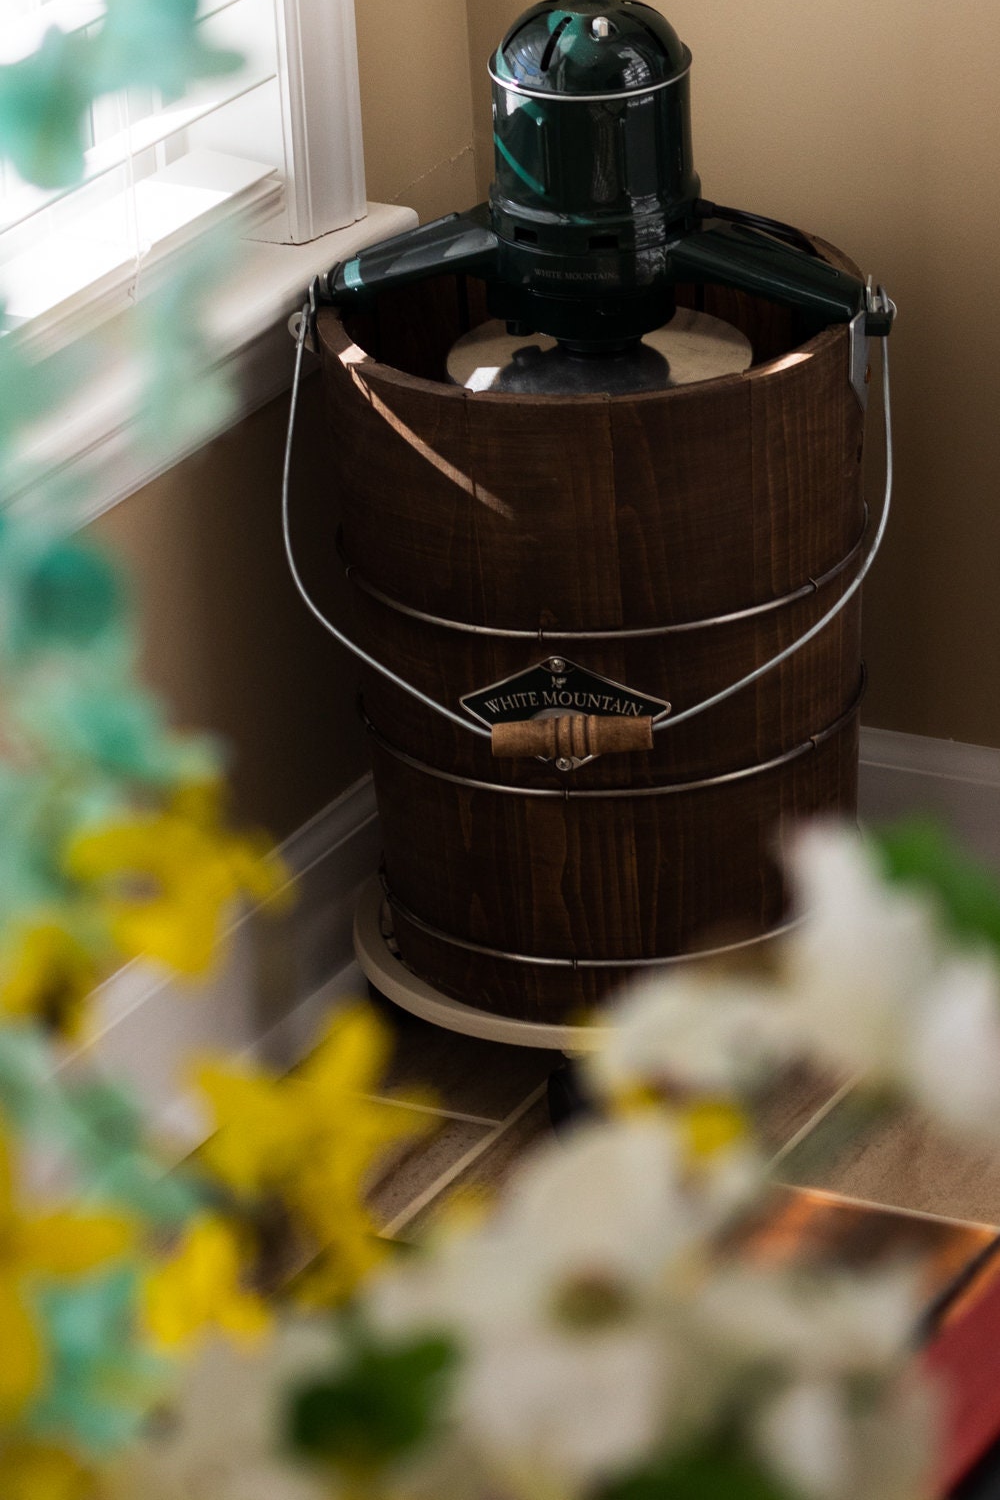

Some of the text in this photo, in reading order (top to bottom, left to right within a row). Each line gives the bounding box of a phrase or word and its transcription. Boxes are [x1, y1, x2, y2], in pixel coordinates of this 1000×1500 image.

[534, 267, 615, 282] WHITE MOUNTAIN
[484, 691, 644, 716] WHITE MOUNTAIN
